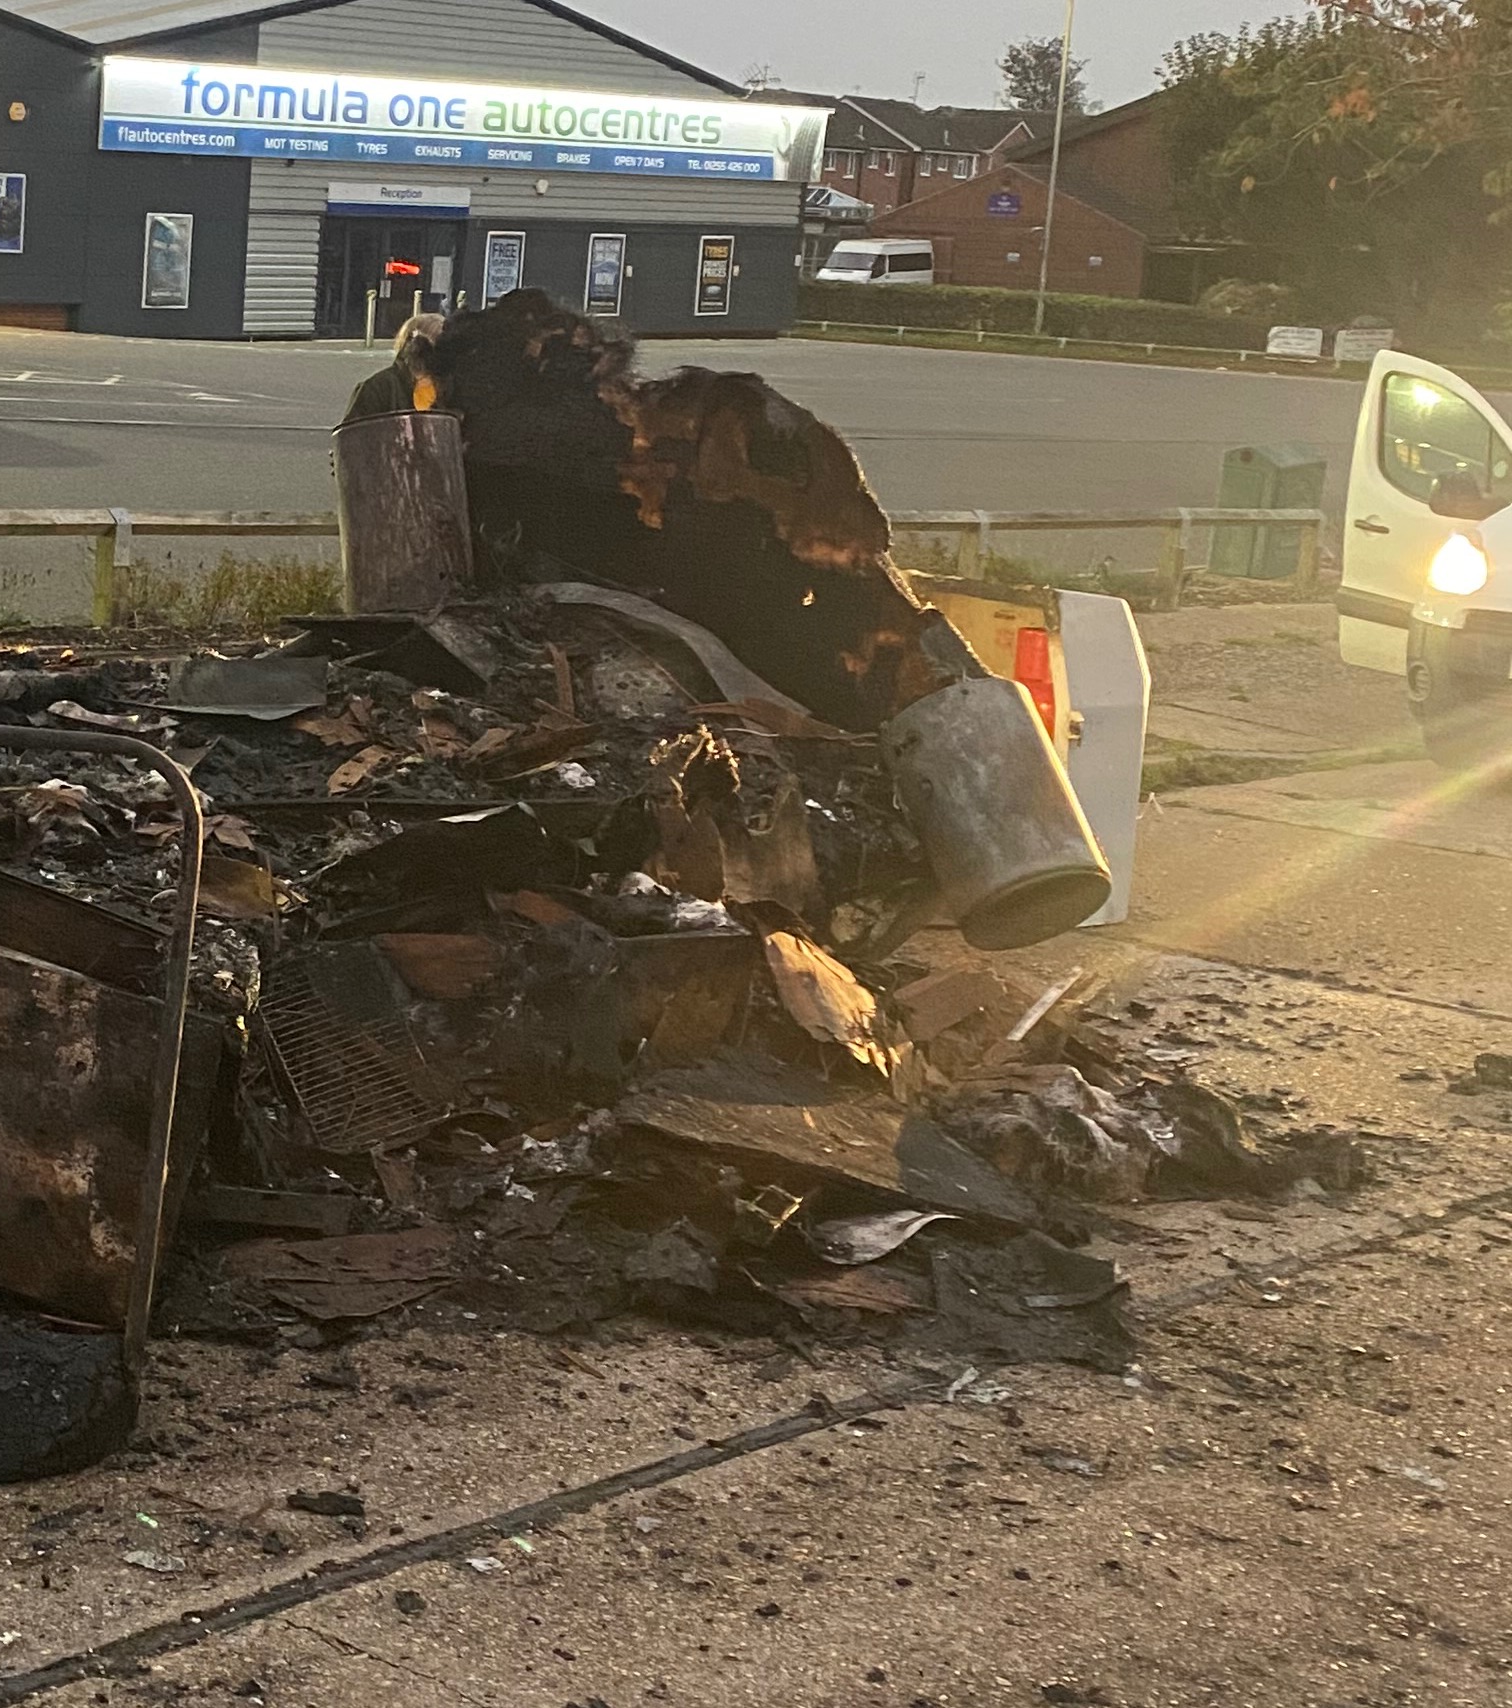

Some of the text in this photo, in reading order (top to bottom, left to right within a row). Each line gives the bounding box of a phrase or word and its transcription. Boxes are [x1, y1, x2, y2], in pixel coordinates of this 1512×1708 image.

[181, 67, 722, 145] formula one autocentres
[118, 126, 236, 147] f1autocentres.com
[264, 137, 329, 152] MOT TESTING
[356, 142, 388, 155] TYRES
[415, 145, 462, 158] EXHAUSTS
[488, 149, 533, 162] SERVICING
[556, 152, 591, 165] BRAKES
[614, 155, 637, 166] OPEN
[644, 156, 665, 168] DAYS
[380, 186, 423, 200] Reception
[492, 242, 517, 258] FREE
